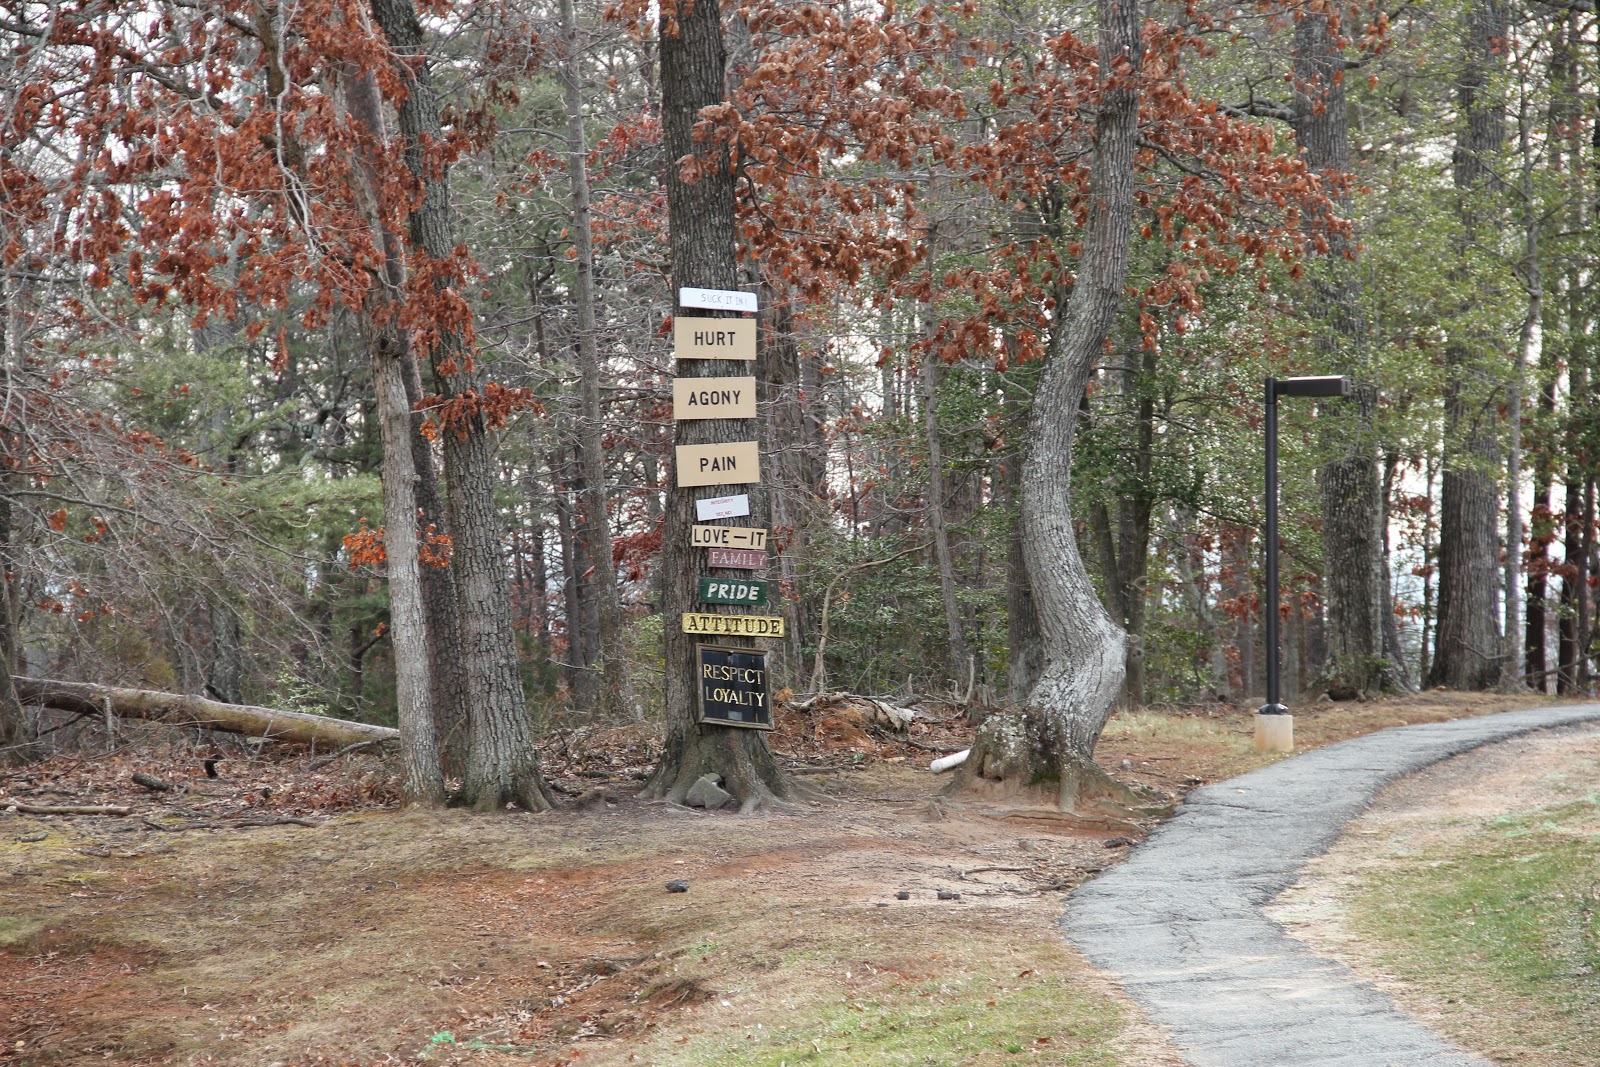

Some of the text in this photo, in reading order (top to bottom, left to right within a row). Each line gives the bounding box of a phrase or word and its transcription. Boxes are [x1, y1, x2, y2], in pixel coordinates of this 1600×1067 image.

[701, 293, 722, 304] SUCK
[725, 295, 733, 305] IT
[694, 331, 736, 346] HURT
[688, 390, 741, 406] AGONY
[699, 456, 736, 473] PAIN
[711, 551, 766, 567] FAMILY
[707, 582, 760, 601] PRIDE
[688, 616, 780, 635] ATTITUDE
[703, 663, 764, 685] RESPECT
[705, 685, 765, 707] LOYALTY
